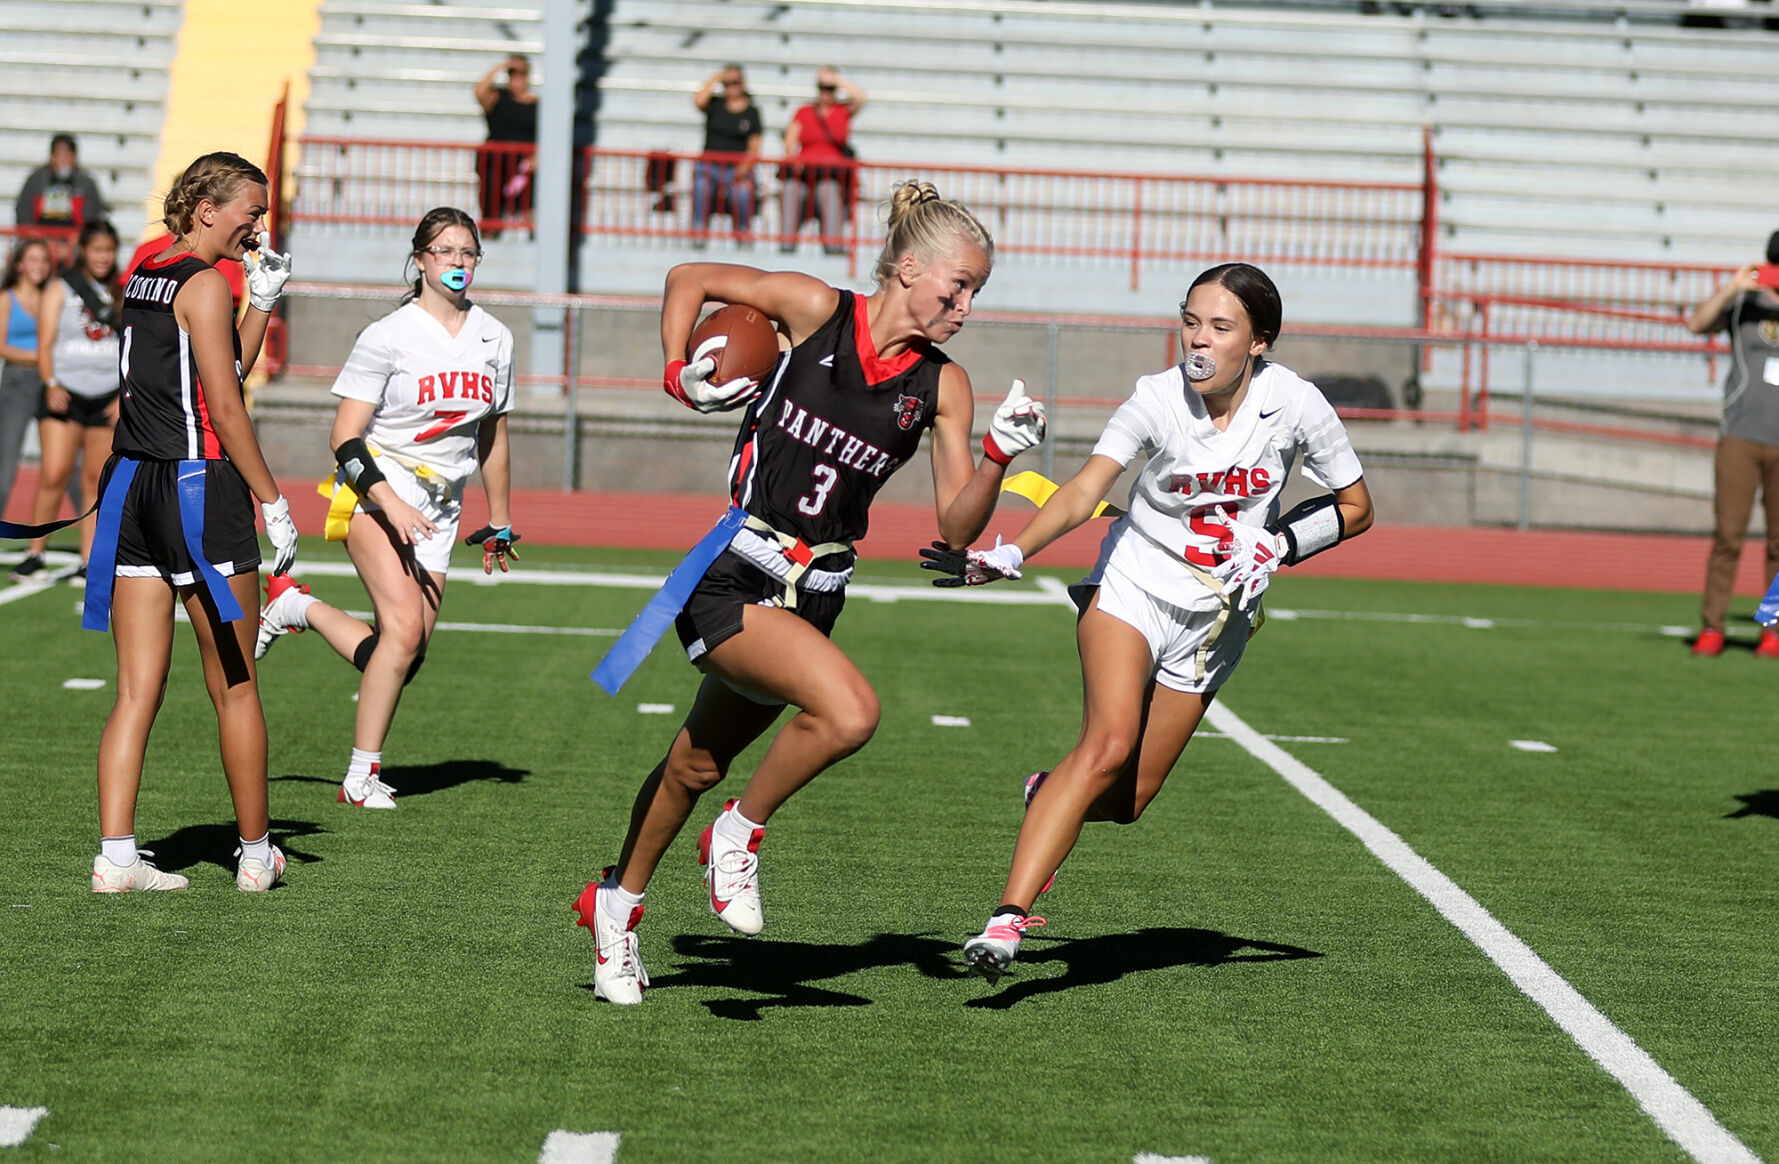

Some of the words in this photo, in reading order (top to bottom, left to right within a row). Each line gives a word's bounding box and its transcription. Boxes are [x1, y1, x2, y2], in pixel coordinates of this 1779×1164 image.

[417, 371, 493, 406] RVHS
[413, 410, 469, 443] 7
[796, 462, 839, 518] 3
[1168, 466, 1272, 498] RVHS
